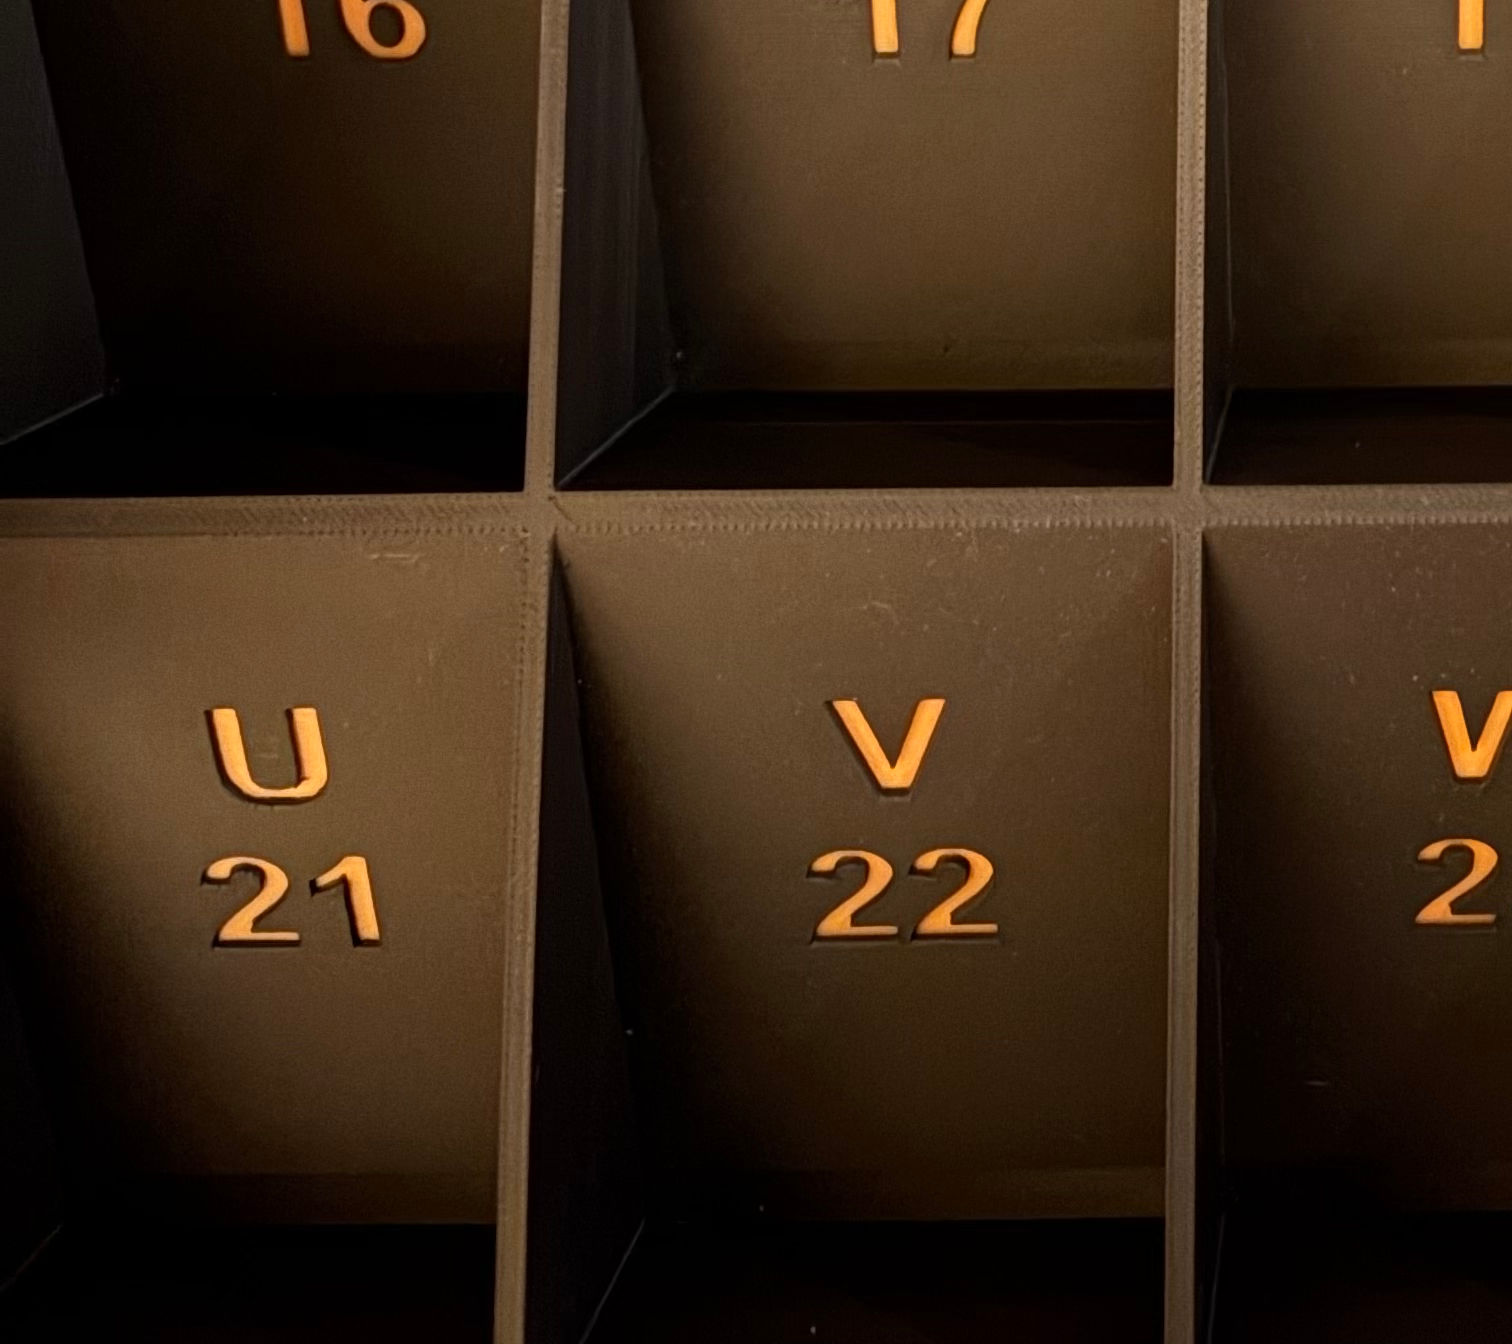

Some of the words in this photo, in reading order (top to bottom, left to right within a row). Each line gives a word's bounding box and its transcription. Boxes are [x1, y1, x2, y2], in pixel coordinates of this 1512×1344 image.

[208, 705, 328, 800] U
[833, 696, 947, 791] V
[206, 854, 382, 945] 21
[810, 847, 998, 940] 22
